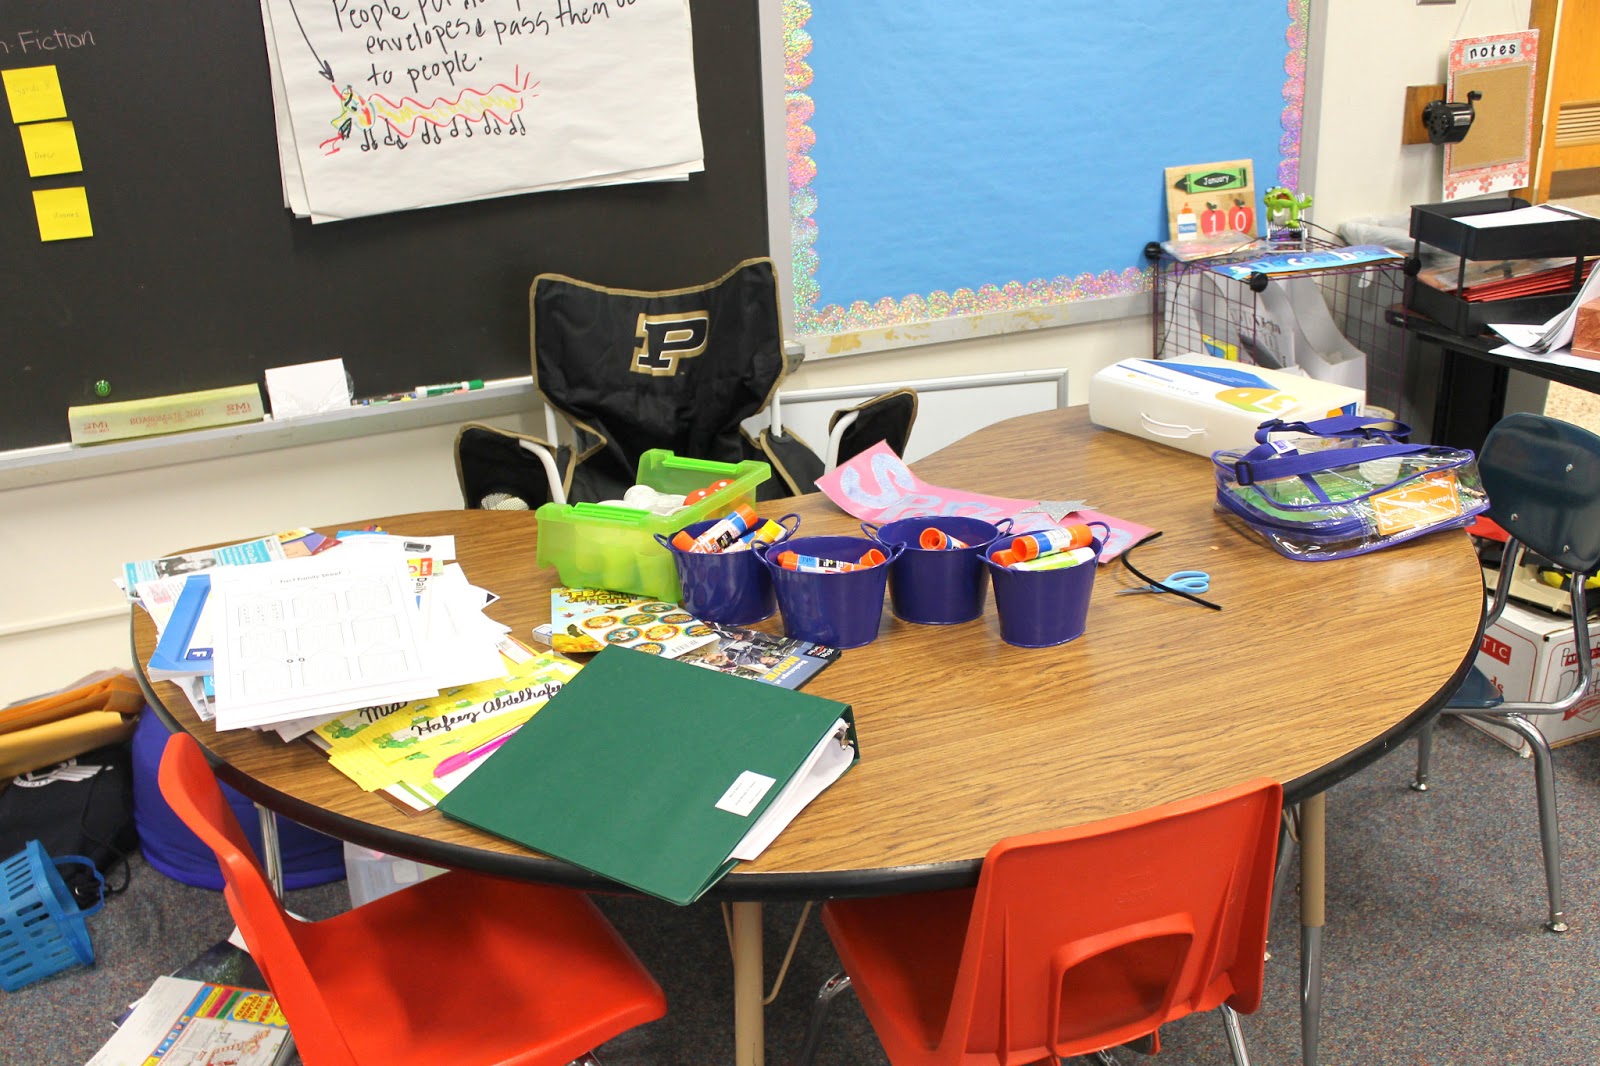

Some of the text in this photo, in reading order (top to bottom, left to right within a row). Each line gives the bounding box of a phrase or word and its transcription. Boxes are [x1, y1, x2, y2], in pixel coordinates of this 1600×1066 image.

[366, 18, 470, 54] envelopes
[494, 12, 550, 45] pass
[555, 0, 610, 27] them
[367, 51, 483, 93] to people.
[1469, 43, 1516, 59] notes
[1203, 175, 1230, 186] January
[630, 310, 709, 376] P
